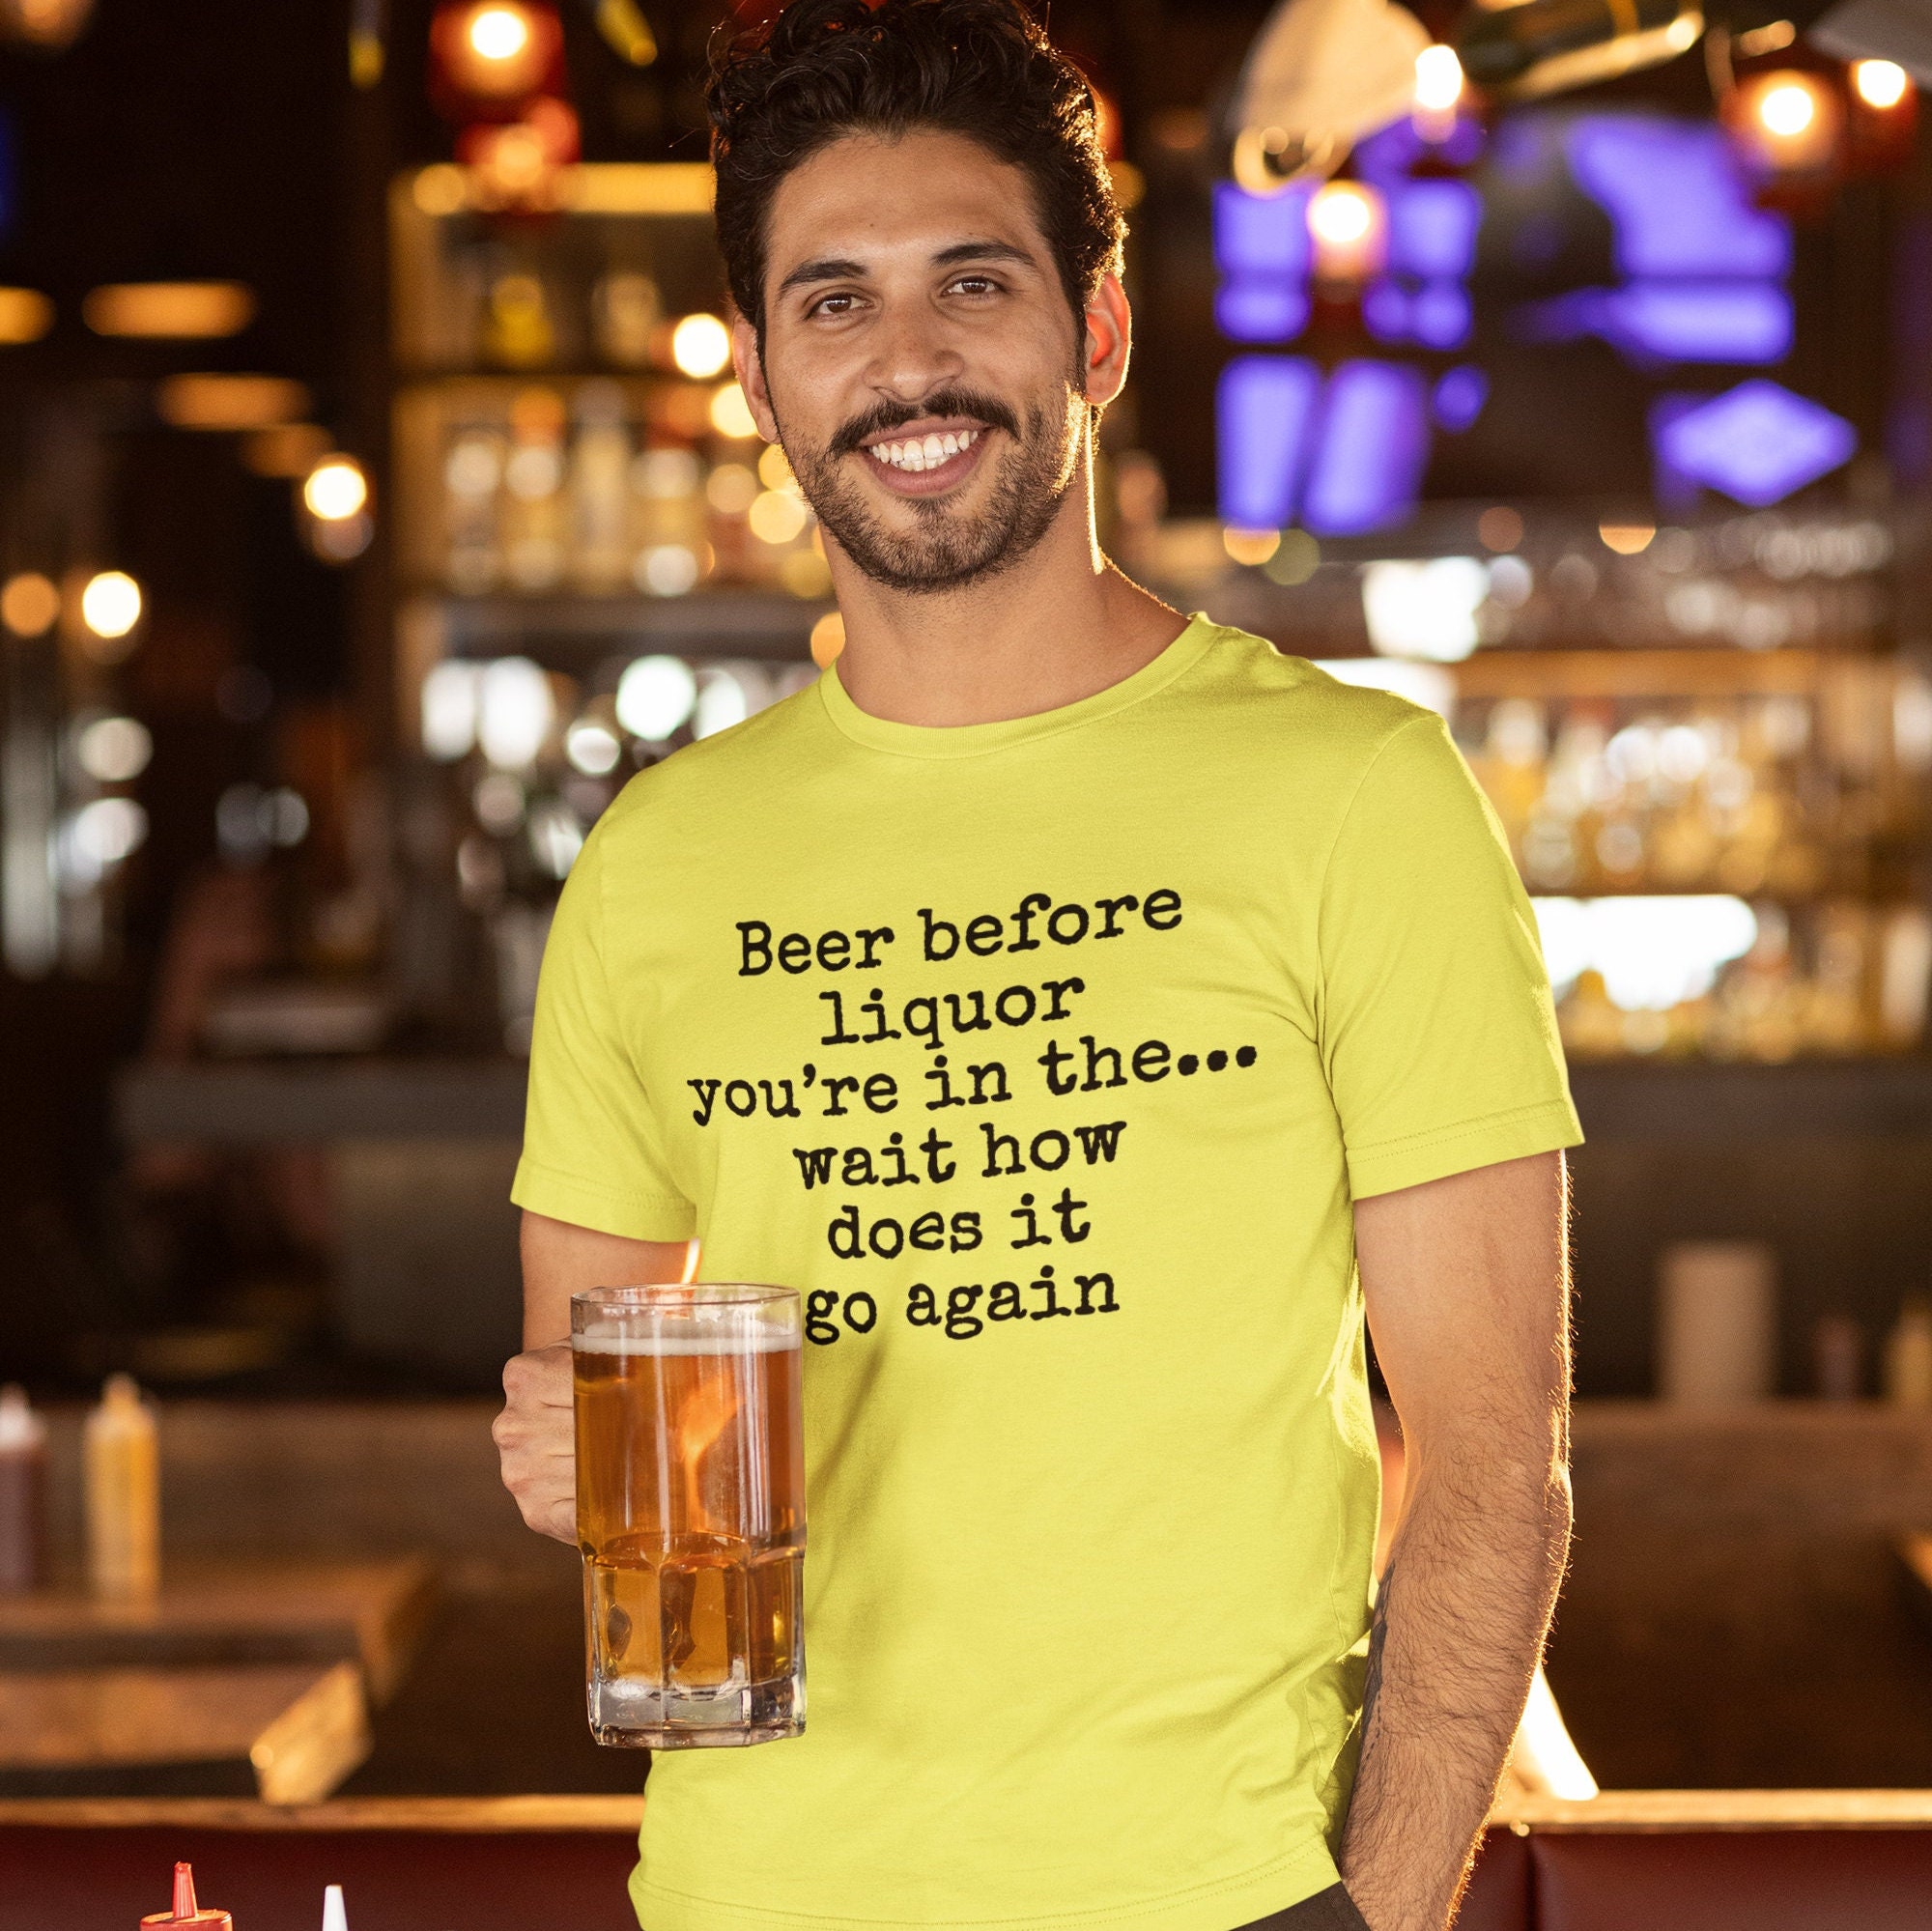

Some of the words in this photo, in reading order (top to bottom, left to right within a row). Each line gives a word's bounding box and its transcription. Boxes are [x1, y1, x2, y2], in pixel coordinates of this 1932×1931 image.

[735, 920, 895, 977] Beer
[917, 888, 1182, 962] before
[818, 977, 1086, 1051] liquor
[924, 1054, 1012, 1111] in
[792, 1127, 956, 1190] wait
[979, 1121, 1127, 1178] how
[827, 1205, 983, 1260] does
[1010, 1187, 1091, 1250] it
[805, 1289, 877, 1347] go
[906, 1264, 1121, 1341] again
